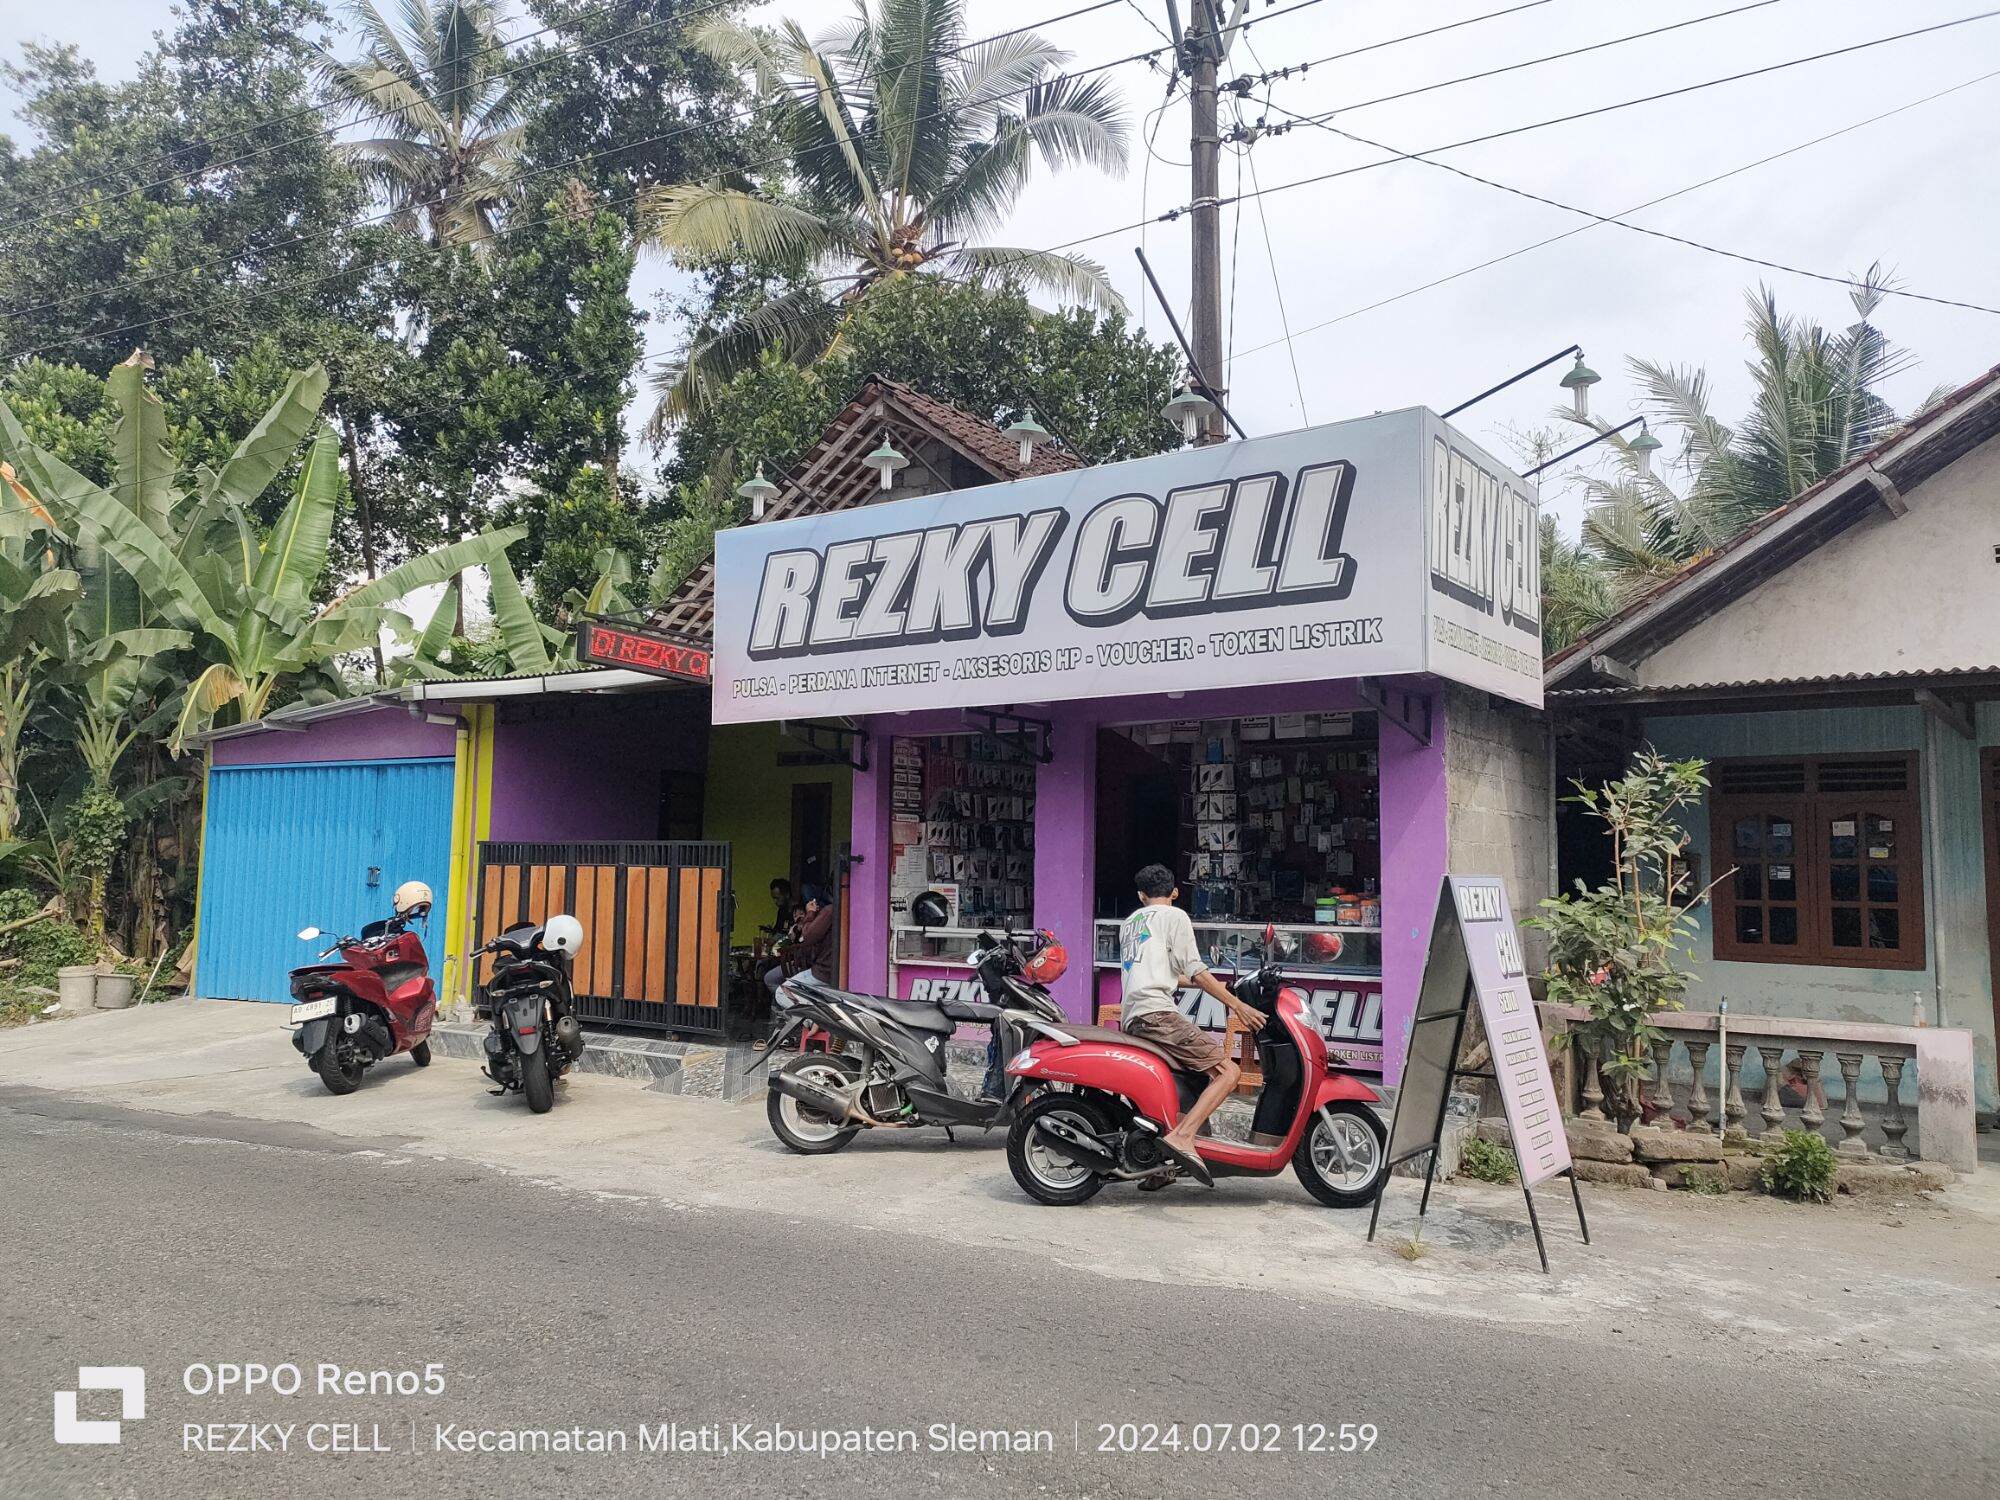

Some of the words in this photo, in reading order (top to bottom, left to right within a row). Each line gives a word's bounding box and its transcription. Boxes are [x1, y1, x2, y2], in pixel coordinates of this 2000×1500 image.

[747, 505, 1069, 661] REZKY
[1064, 459, 1359, 627] CELL
[1431, 433, 1499, 617] REZKY
[1500, 481, 1541, 637] CELL
[619, 636, 688, 669] REZKY
[732, 677, 778, 699] PULSA
[788, 670, 858, 695] PERDANA
[861, 661, 941, 687] INTERNET
[953, 650, 1052, 681] AKSESORIS
[1056, 647, 1082, 671] HP
[1097, 636, 1194, 668] VOUCHER
[1209, 627, 1285, 657] TOKEN
[1290, 617, 1383, 649] LISTRIK
[1459, 885, 1503, 923] REZKY
[1496, 931, 1524, 979] CELL
